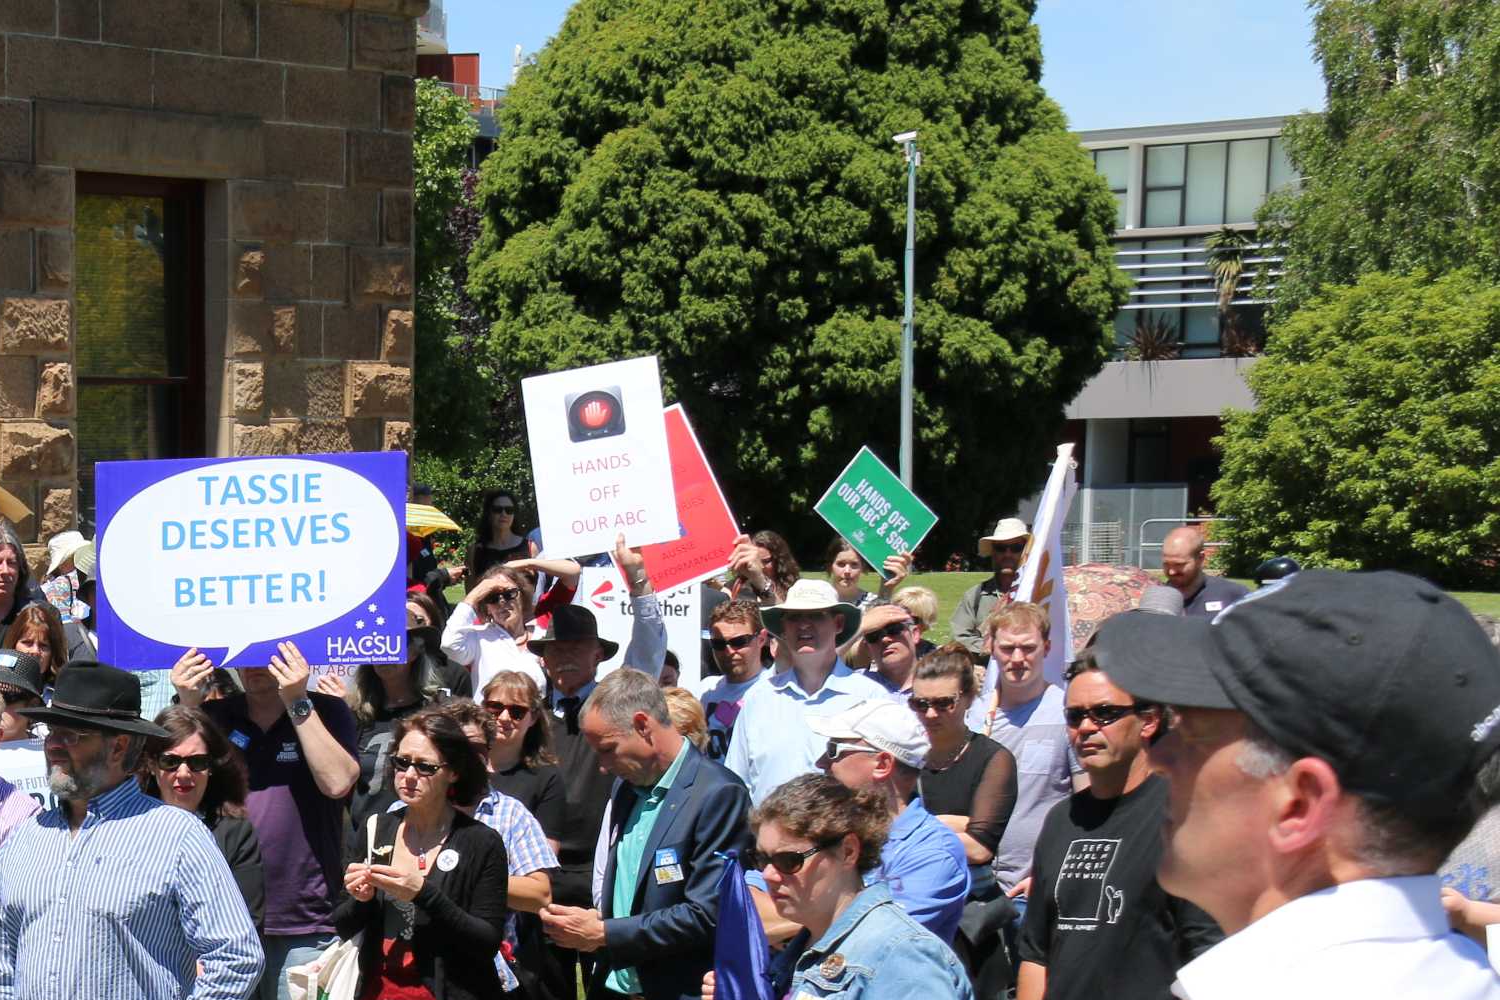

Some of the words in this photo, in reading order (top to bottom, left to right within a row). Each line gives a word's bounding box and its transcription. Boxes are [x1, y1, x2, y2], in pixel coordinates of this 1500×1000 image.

[572, 453, 631, 475] HANDS
[197, 472, 322, 506] TASSIE
[589, 484, 621, 502] OFF
[855, 478, 891, 516] HANDS
[887, 511, 911, 533] OFF
[161, 512, 350, 551] DESERVES
[571, 515, 608, 535] OUR
[614, 509, 647, 529] ABC
[837, 483, 861, 509] OUR
[856, 503, 881, 528] ABC
[876, 522, 889, 537] &
[886, 531, 909, 556] SBS
[652, 547, 726, 583] ERFORMANCES
[174, 570, 326, 607] BETTER!
[327, 635, 401, 656] HACSU
